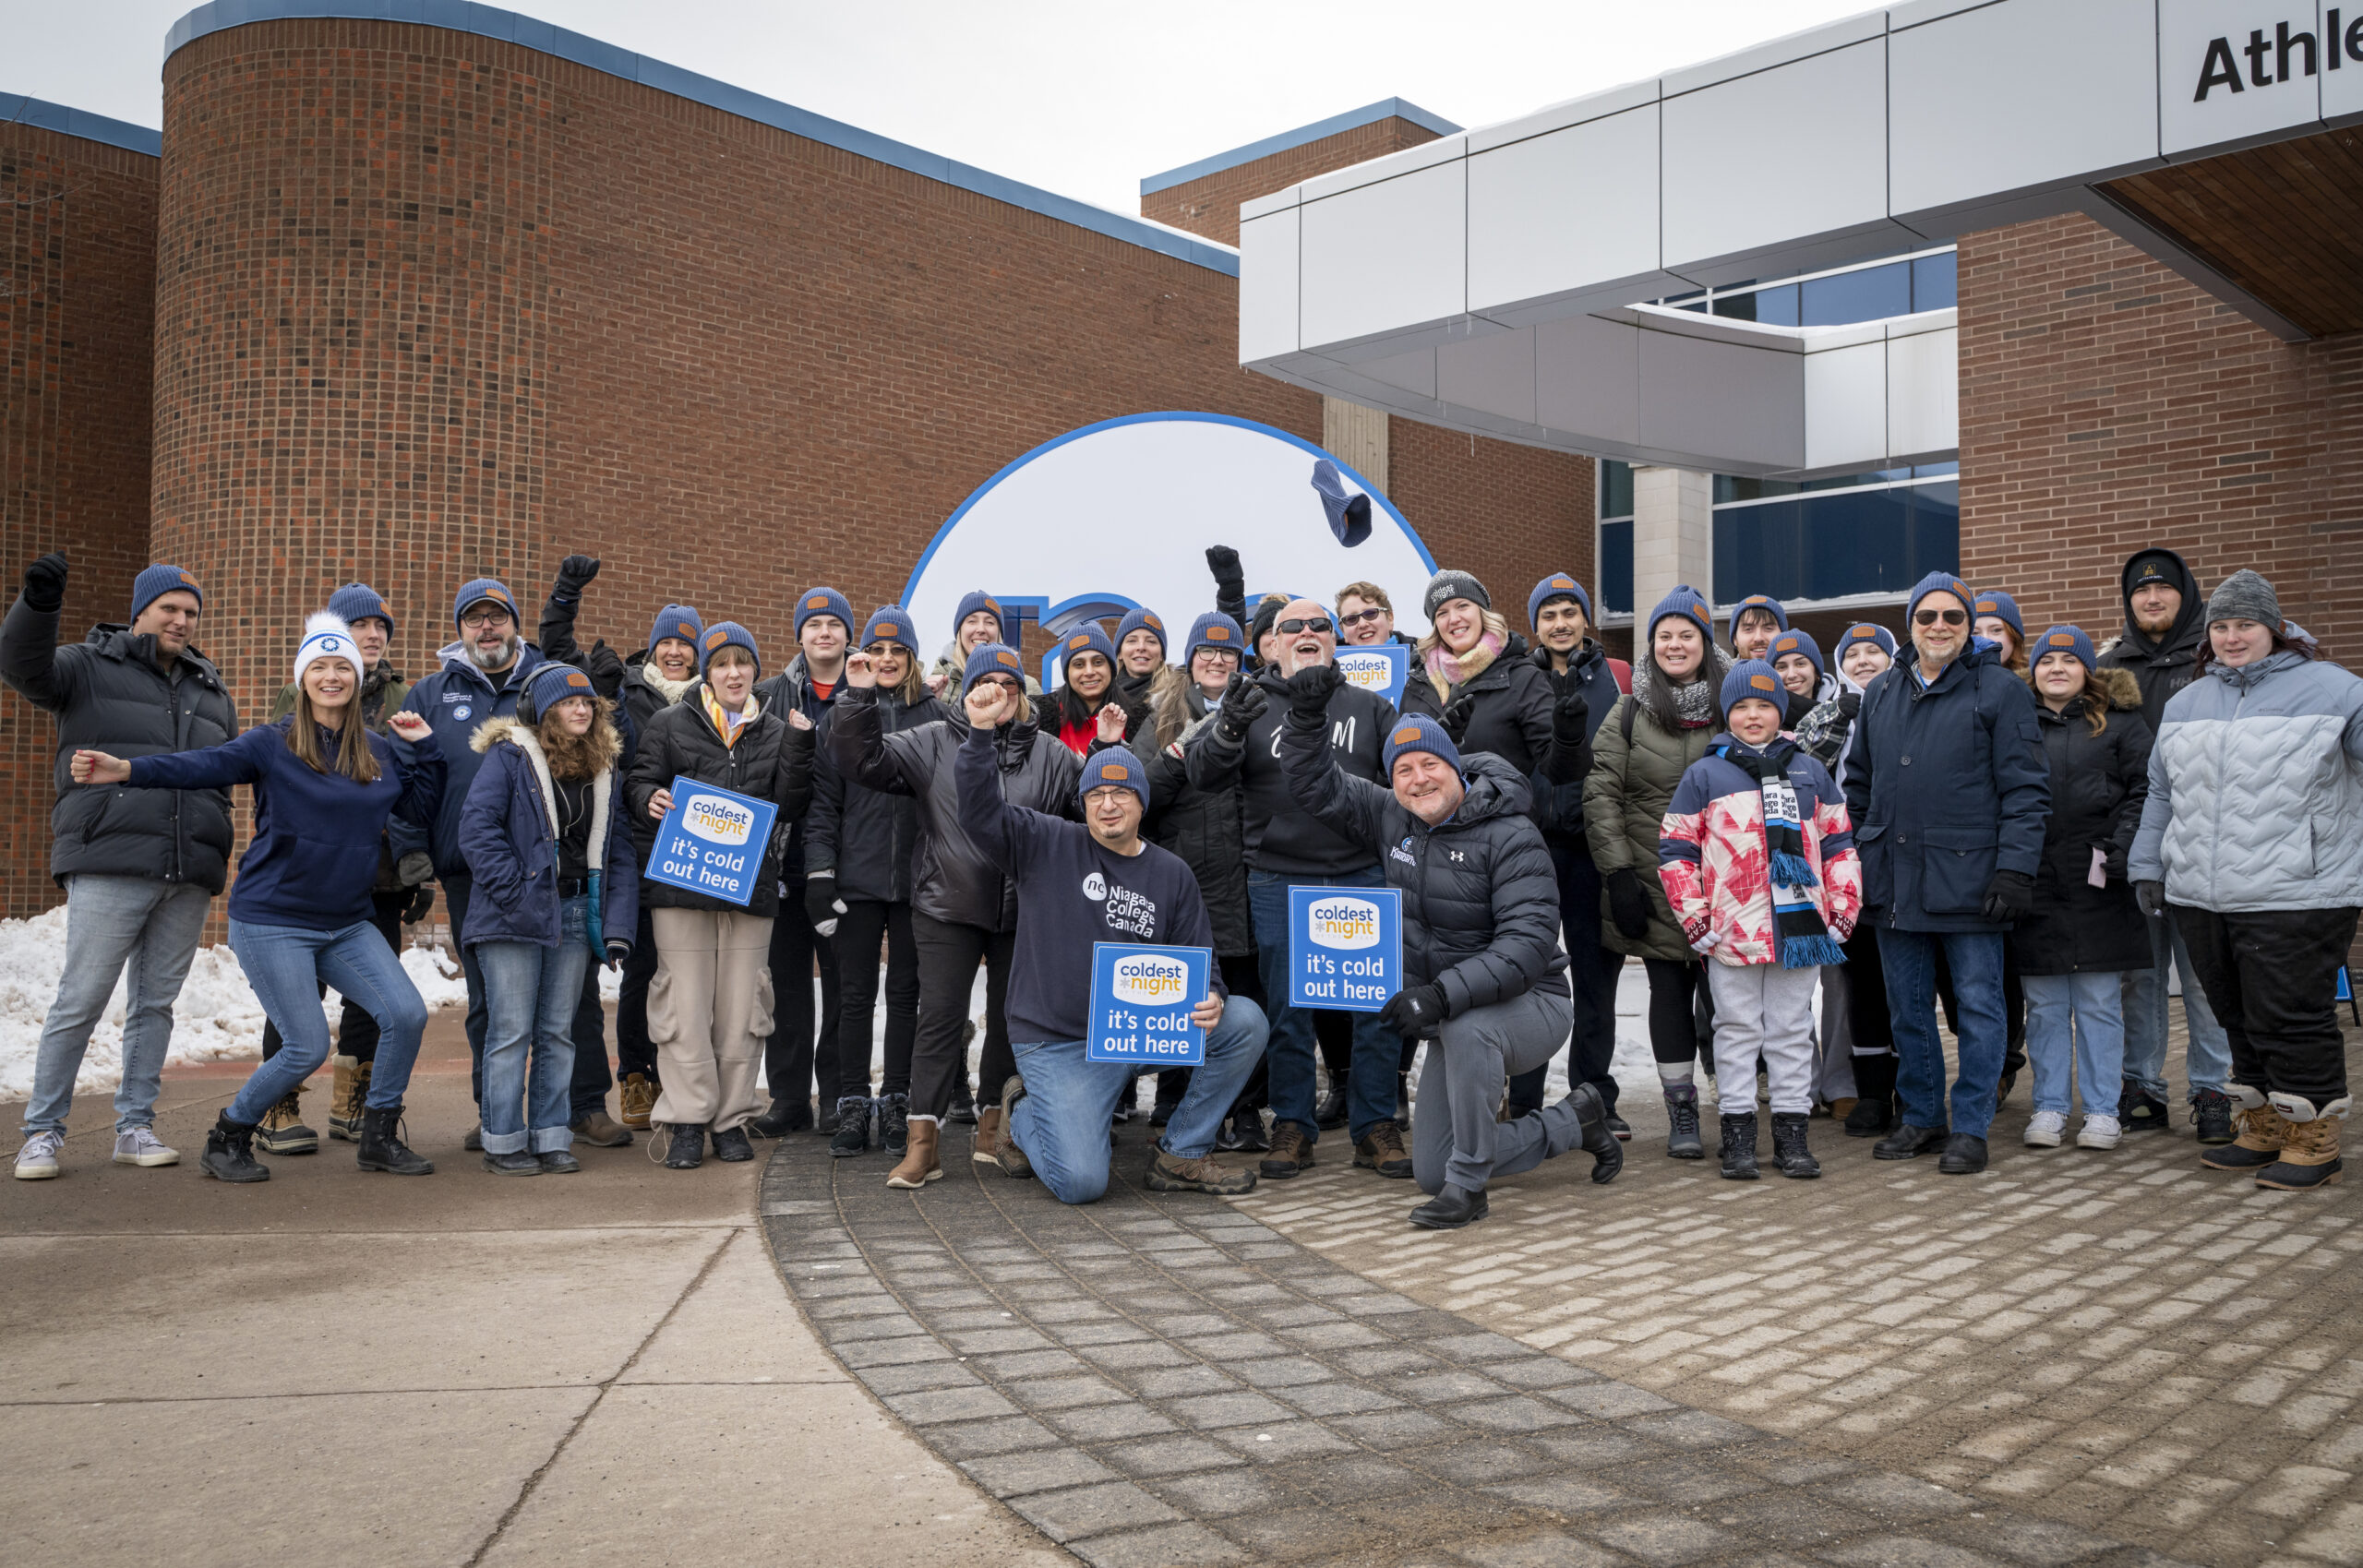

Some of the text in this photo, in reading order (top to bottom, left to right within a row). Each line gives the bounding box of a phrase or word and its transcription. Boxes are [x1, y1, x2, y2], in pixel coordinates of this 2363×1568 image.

[1339, 659, 1386, 671] coldest
[1347, 668, 1386, 685] night
[693, 802, 749, 824] coldest
[699, 813, 745, 835] night
[671, 836, 745, 872] it's cold
[663, 860, 739, 892] out here
[1087, 880, 1105, 893] nc
[1106, 899, 1156, 925] College
[1315, 905, 1373, 921] coldest
[1106, 913, 1154, 938] Canada
[1325, 918, 1373, 940] night
[1121, 963, 1182, 978] coldest
[1307, 953, 1384, 976] it's cold
[1131, 976, 1181, 995] night
[1304, 979, 1385, 1000] out here
[1108, 1010, 1189, 1032] it's cold
[1104, 1034, 1189, 1054] out here
